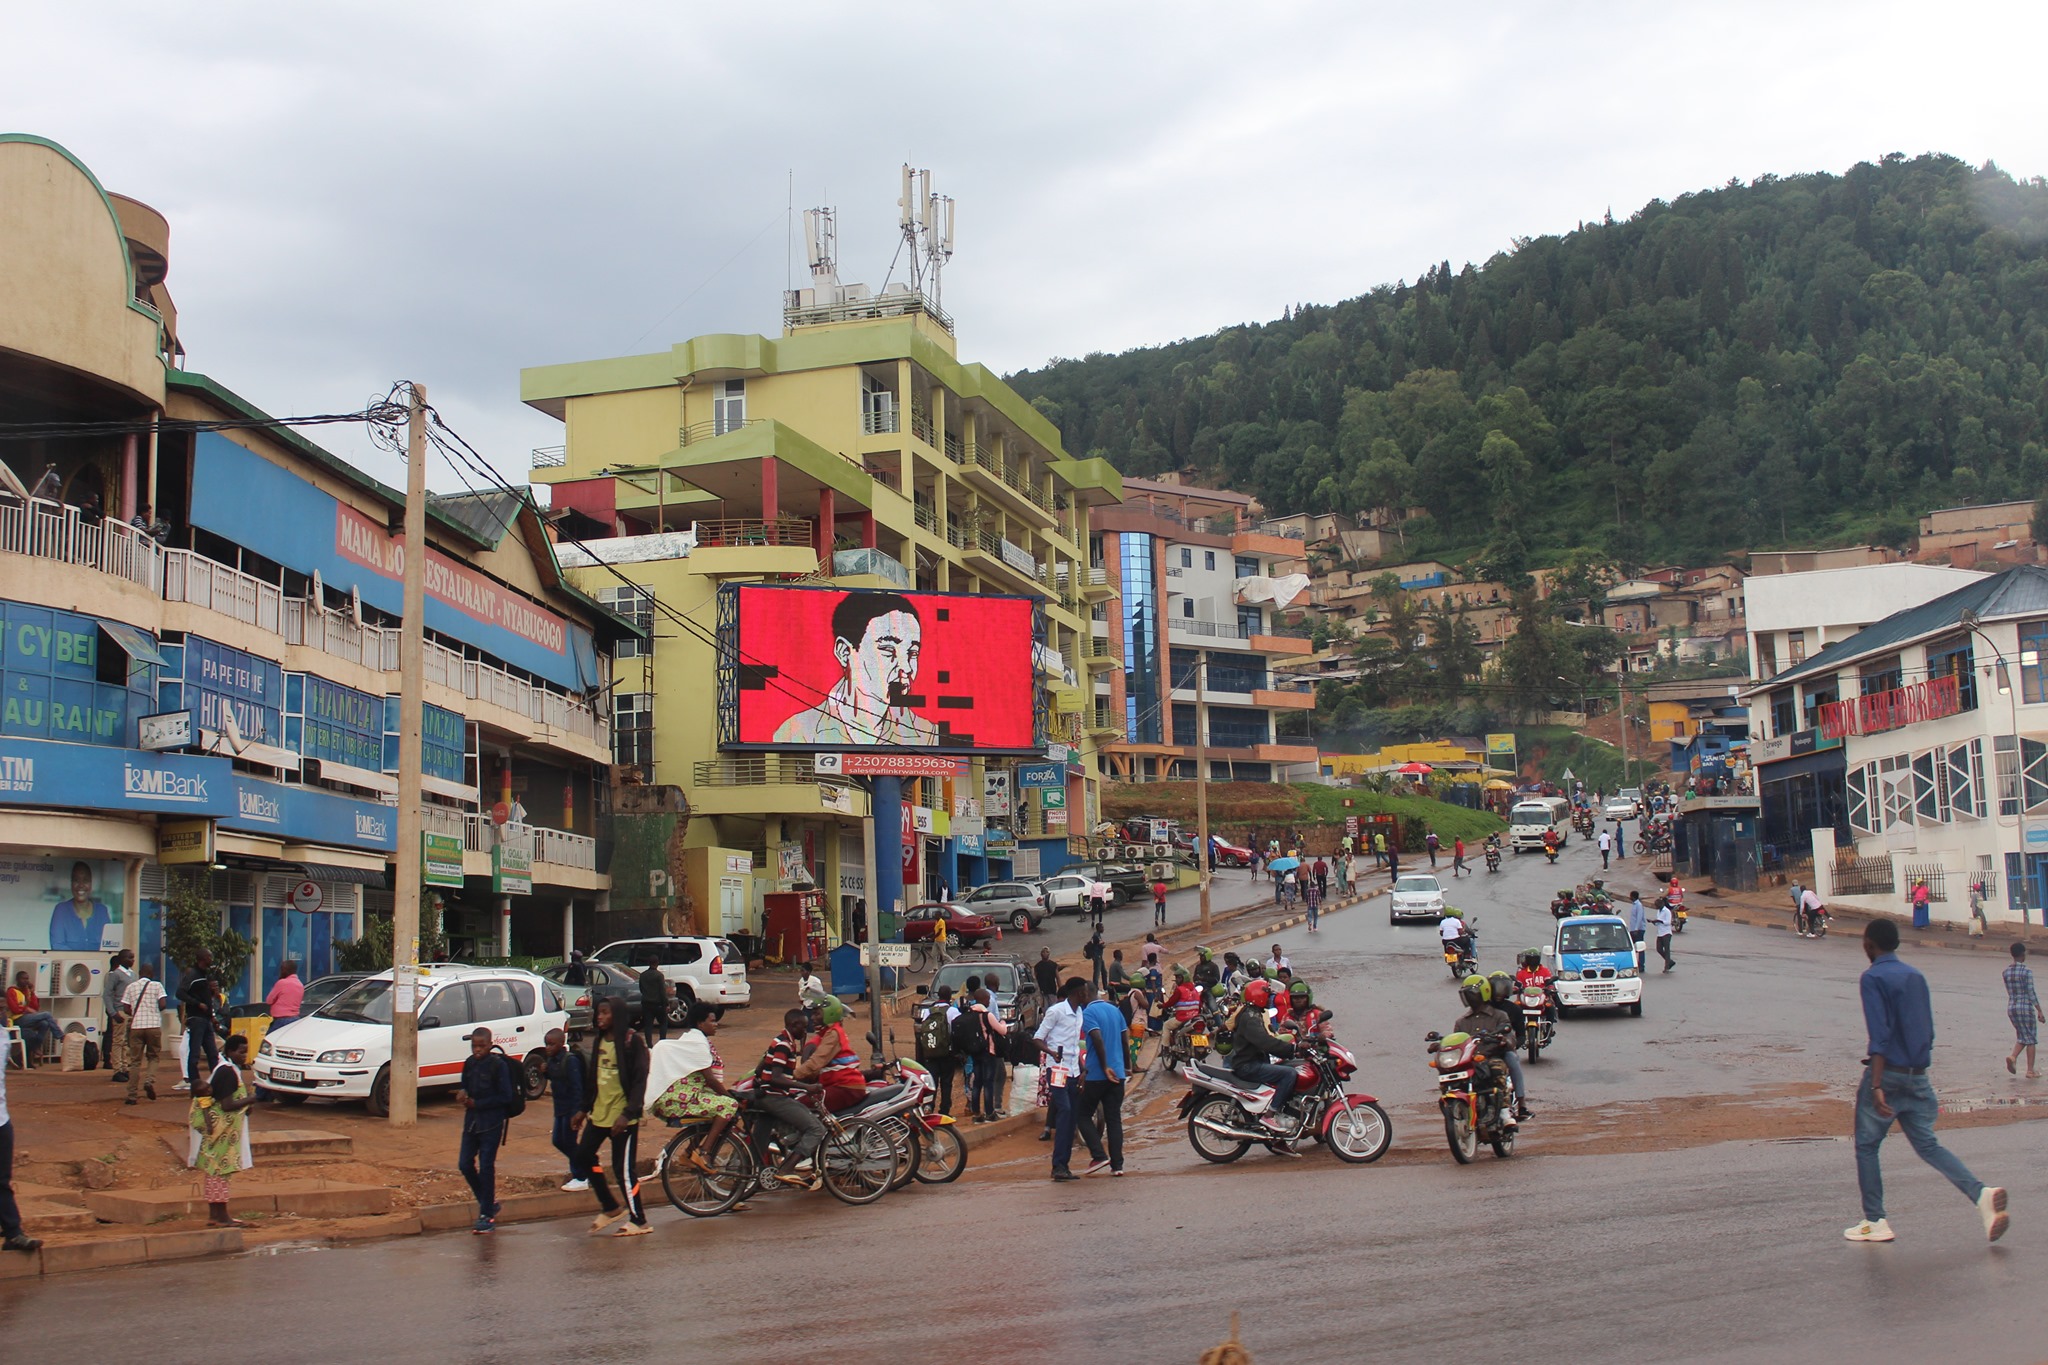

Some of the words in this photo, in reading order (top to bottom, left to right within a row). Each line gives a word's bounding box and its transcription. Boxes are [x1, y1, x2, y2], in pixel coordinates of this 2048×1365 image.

[341, 513, 382, 568] MAMA
[385, 540, 406, 576] BO
[424, 559, 496, 620] ESTAURANT
[502, 596, 562, 651] NYABUGOGO
[313, 684, 374, 732] HAMZA
[201, 692, 264, 739] HOZON
[1765, 739, 1783, 749] Urwego
[13, 781, 34, 792] 24/7
[507, 848, 523, 860] GOAL
[502, 857, 531, 871] PHARMACY
[1525, 976, 1545, 987] STAR
